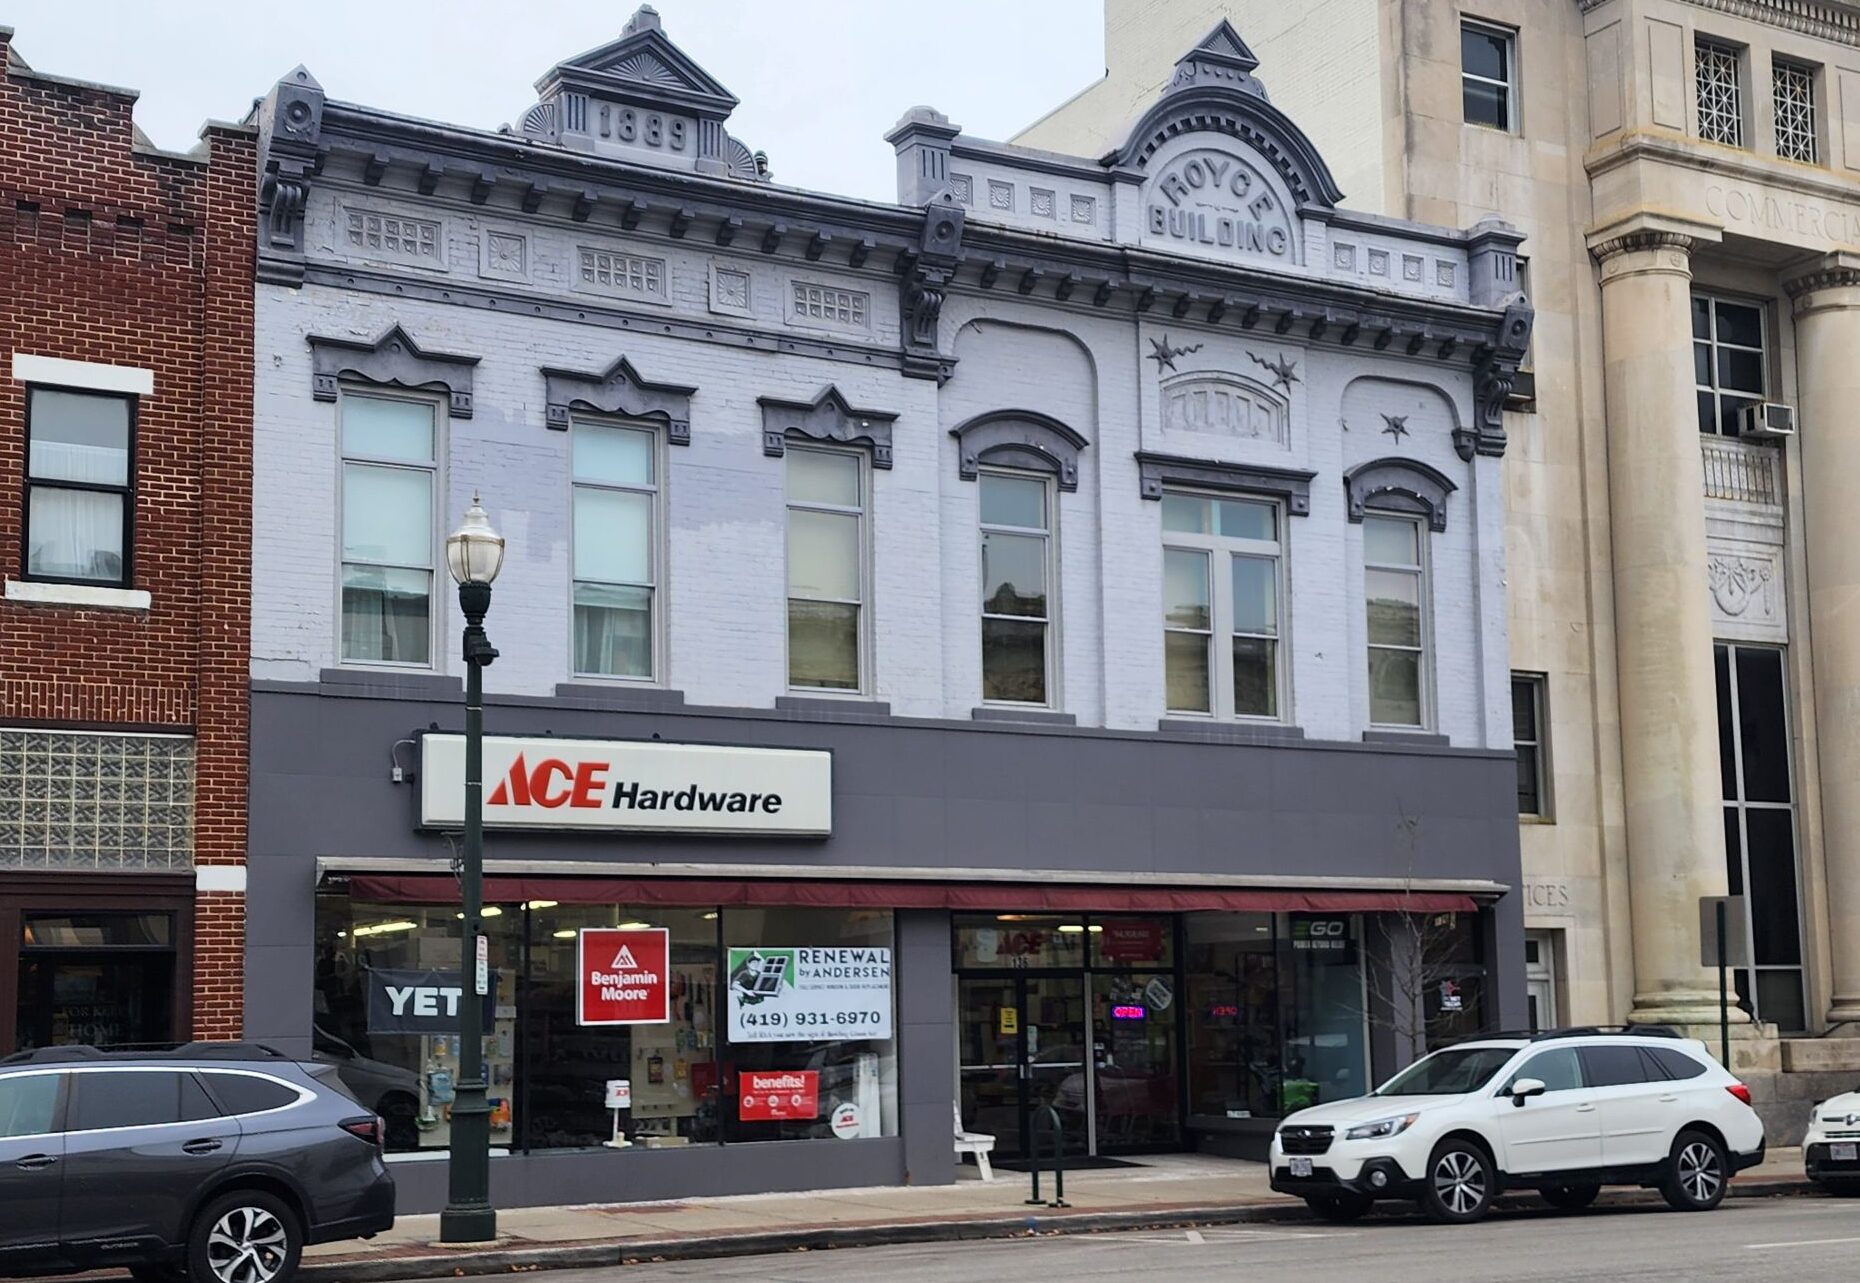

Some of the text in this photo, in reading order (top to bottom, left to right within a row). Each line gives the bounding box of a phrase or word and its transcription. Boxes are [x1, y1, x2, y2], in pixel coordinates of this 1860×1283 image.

[600, 104, 686, 151] 1889
[1160, 157, 1274, 222] ROYCE
[1149, 204, 1287, 255] BUILDING
[486, 750, 783, 814] ACE Hardware
[1523, 884, 1568, 906] ICES
[799, 950, 889, 964] RENEWAL
[591, 970, 658, 988] Benjamin
[799, 967, 889, 978] by ANDERSEN
[384, 986, 463, 1017] YET
[601, 987, 648, 1001] Moore
[740, 1011, 881, 1029] (419) 931-6970
[1112, 1006, 1144, 1018] OPEN
[752, 1074, 805, 1089] benefits!
